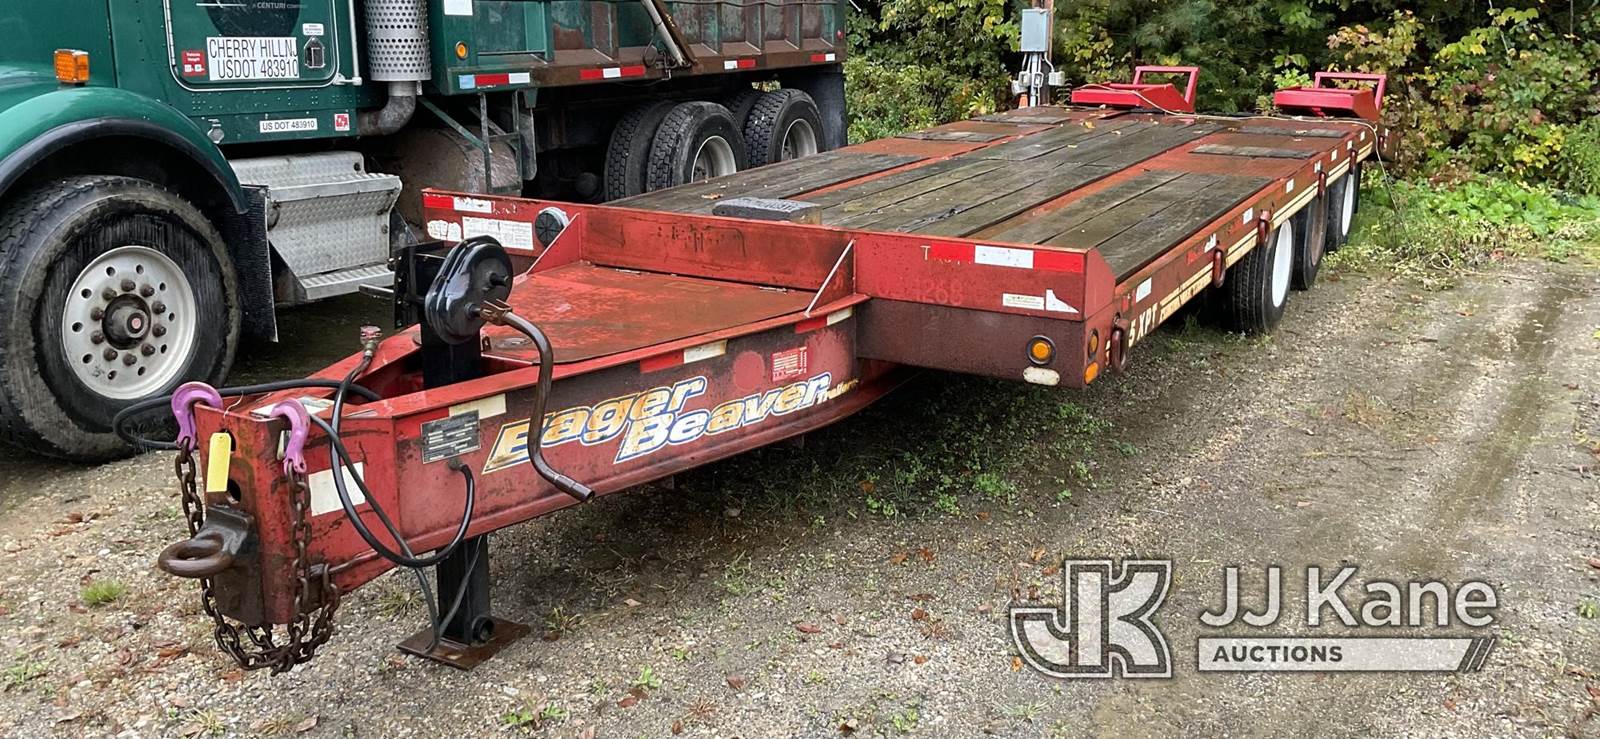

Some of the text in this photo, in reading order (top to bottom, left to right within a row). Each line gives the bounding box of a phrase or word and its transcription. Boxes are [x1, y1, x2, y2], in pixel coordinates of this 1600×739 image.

[209, 39, 256, 58] CHERRY
[218, 59, 256, 79] USDOT
[260, 58, 299, 78] 483910
[262, 120, 315, 130] US DOT 483910
[1136, 302, 1158, 341] XPT
[482, 375, 707, 475] Eager
[613, 372, 831, 464] Beaver
